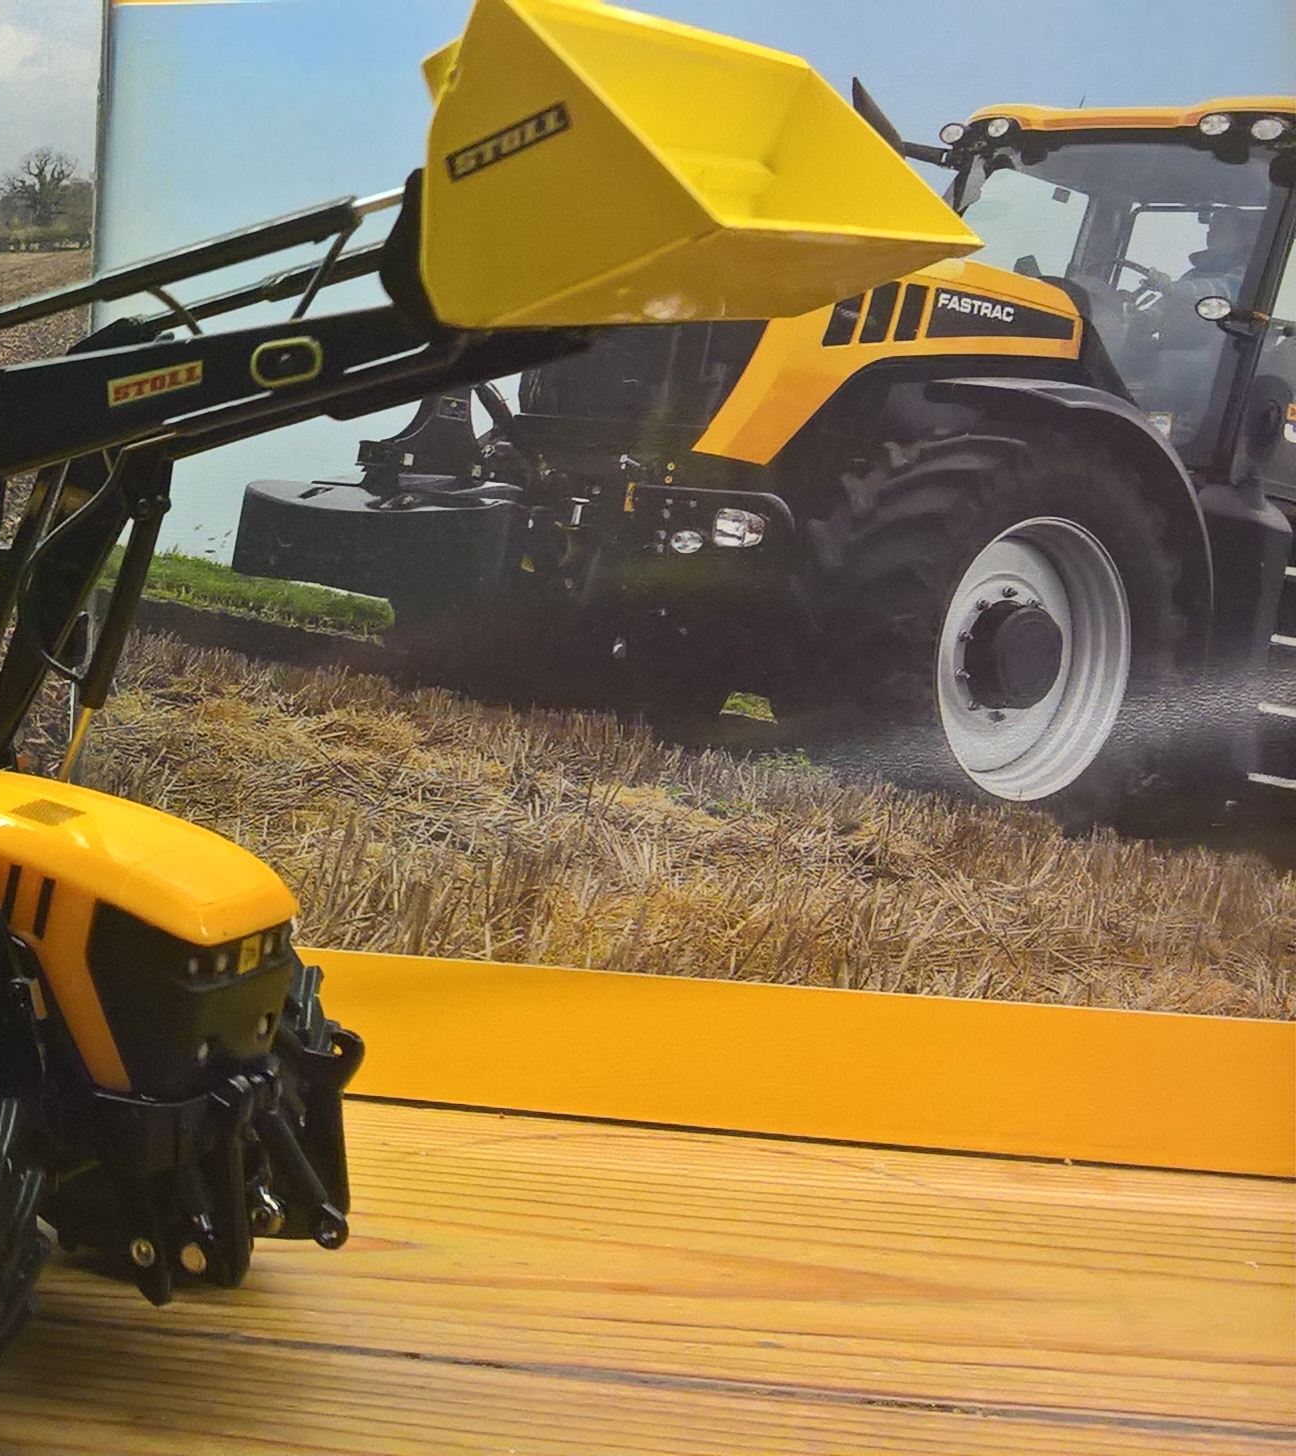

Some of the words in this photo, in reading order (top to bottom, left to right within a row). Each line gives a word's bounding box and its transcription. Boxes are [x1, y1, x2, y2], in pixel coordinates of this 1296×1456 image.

[454, 110, 565, 178] STOLL
[937, 293, 1015, 323] FASTRAC
[113, 365, 201, 403] STOLL
